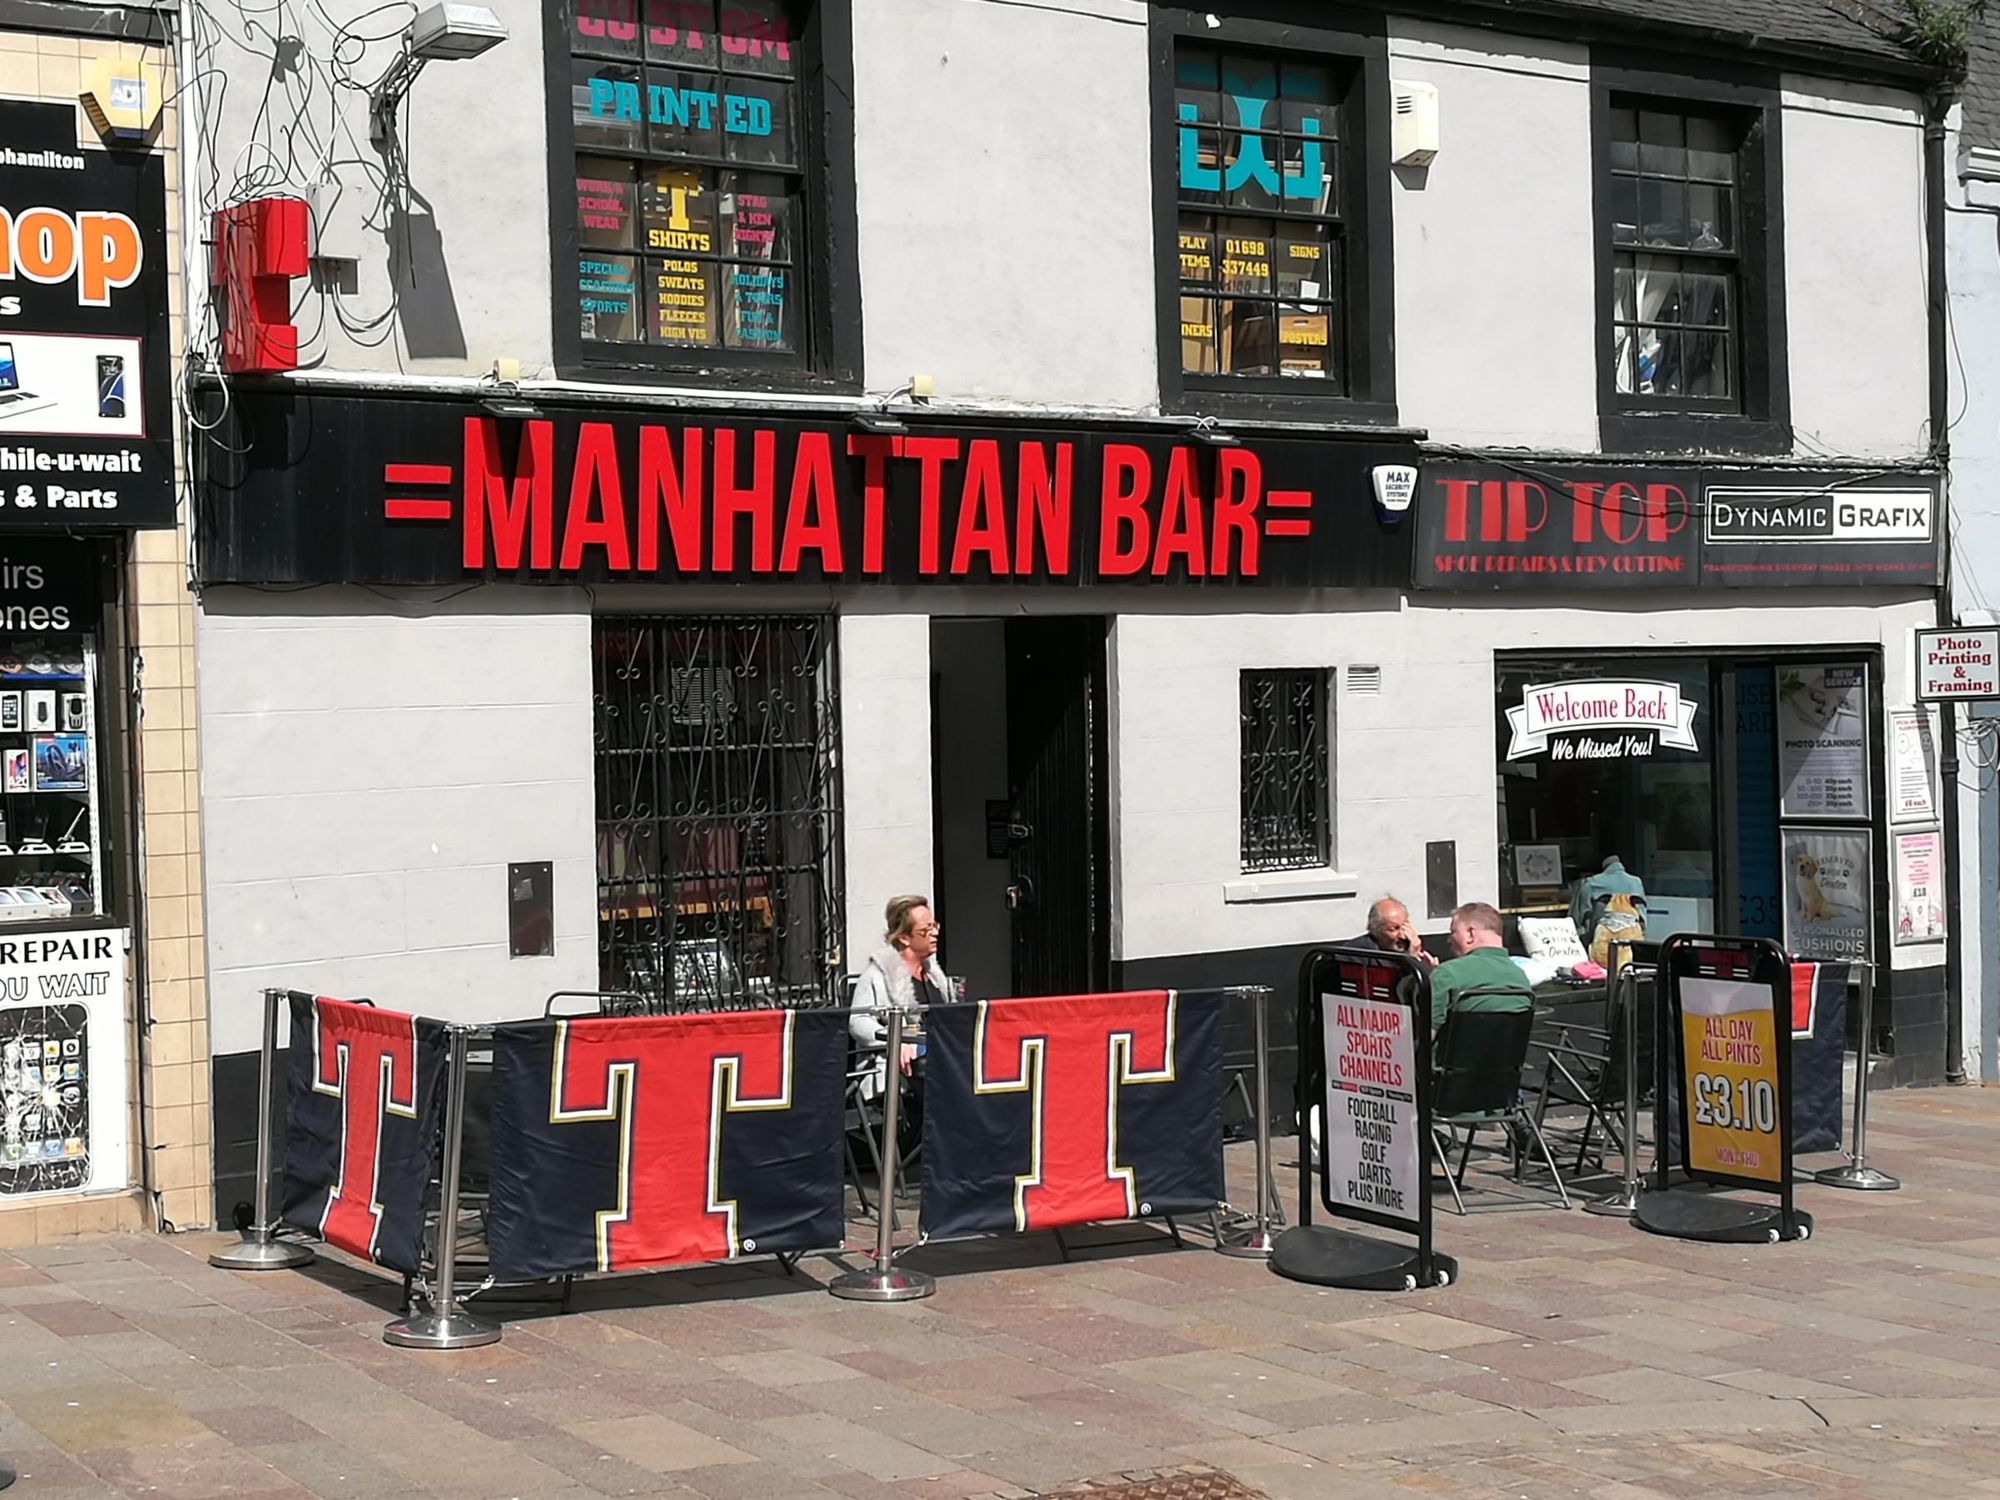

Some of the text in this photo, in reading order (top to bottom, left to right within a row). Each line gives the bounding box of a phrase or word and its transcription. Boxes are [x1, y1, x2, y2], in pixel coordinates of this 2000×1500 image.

[577, 0, 791, 61] CUSTOM
[588, 78, 772, 136] PRINTED
[578, 196, 624, 212] SCHOOL
[737, 194, 768, 208] STAG
[584, 215, 620, 230] WEAR
[738, 211, 746, 223] &
[649, 229, 711, 252] SHIRTS
[1226, 239, 1265, 257] 01698
[1289, 244, 1320, 260] SIGNS
[579, 261, 630, 276] SPECIAL
[663, 259, 698, 273] POLOS
[1222, 258, 1269, 277] 337449
[658, 276, 705, 291] SWEATS
[731, 273, 785, 289] HOLIDAYS
[581, 299, 629, 314] SPORTS
[659, 292, 705, 307] HOODIES
[745, 292, 783, 305] TOURS
[660, 309, 706, 324] FLEECES
[660, 325, 707, 340] HIGH VIS
[1283, 331, 1328, 346] POSTERS
[1386, 471, 1411, 484] MAX
[15, 484, 37, 508] &
[46, 484, 118, 509] Parts
[463, 416, 1262, 577] MANHATTAN BAR
[1435, 479, 1688, 544] TIP TOP
[1714, 502, 1927, 528] DYNAMIC GRAFIX
[3, 556, 45, 590] irs
[1434, 555, 1685, 573] SHOE REPAIRS & KEY CUTTING
[1937, 637, 1982, 651] Photo
[1928, 651, 1992, 666] Printing
[1832, 669, 1855, 678] NEW
[1953, 666, 1966, 679] &
[1928, 678, 1993, 694] Framing
[1536, 688, 1668, 724] Welcome Back
[1552, 732, 1654, 760] We Missed You!
[1785, 738, 1862, 749] PHOTO SCANNING
[1791, 924, 1865, 938] PERSONALISED
[0, 937, 113, 965] REPAIR
[1793, 937, 1866, 954] CUSHIONS
[38, 970, 110, 999] WAIT
[1337, 1004, 1401, 1036] ALL MAJOR
[1704, 1018, 1753, 1042] ALL DAY
[1347, 1031, 1393, 1060] SPORTS
[1701, 1040, 1761, 1066] ALL PINTS
[1339, 1054, 1403, 1087] CHANNELS
[974, 989, 1179, 1233] T
[1347, 1097, 1398, 1125] FOOTBALL
[1693, 1072, 1776, 1134] £3.10
[312, 996, 419, 1262] T
[1355, 1120, 1392, 1145] RACING
[549, 1008, 795, 1273] T
[1361, 1141, 1387, 1164] GOLF
[1359, 1161, 1392, 1187] DARTS
[1348, 1180, 1405, 1210] PLUS MORE
